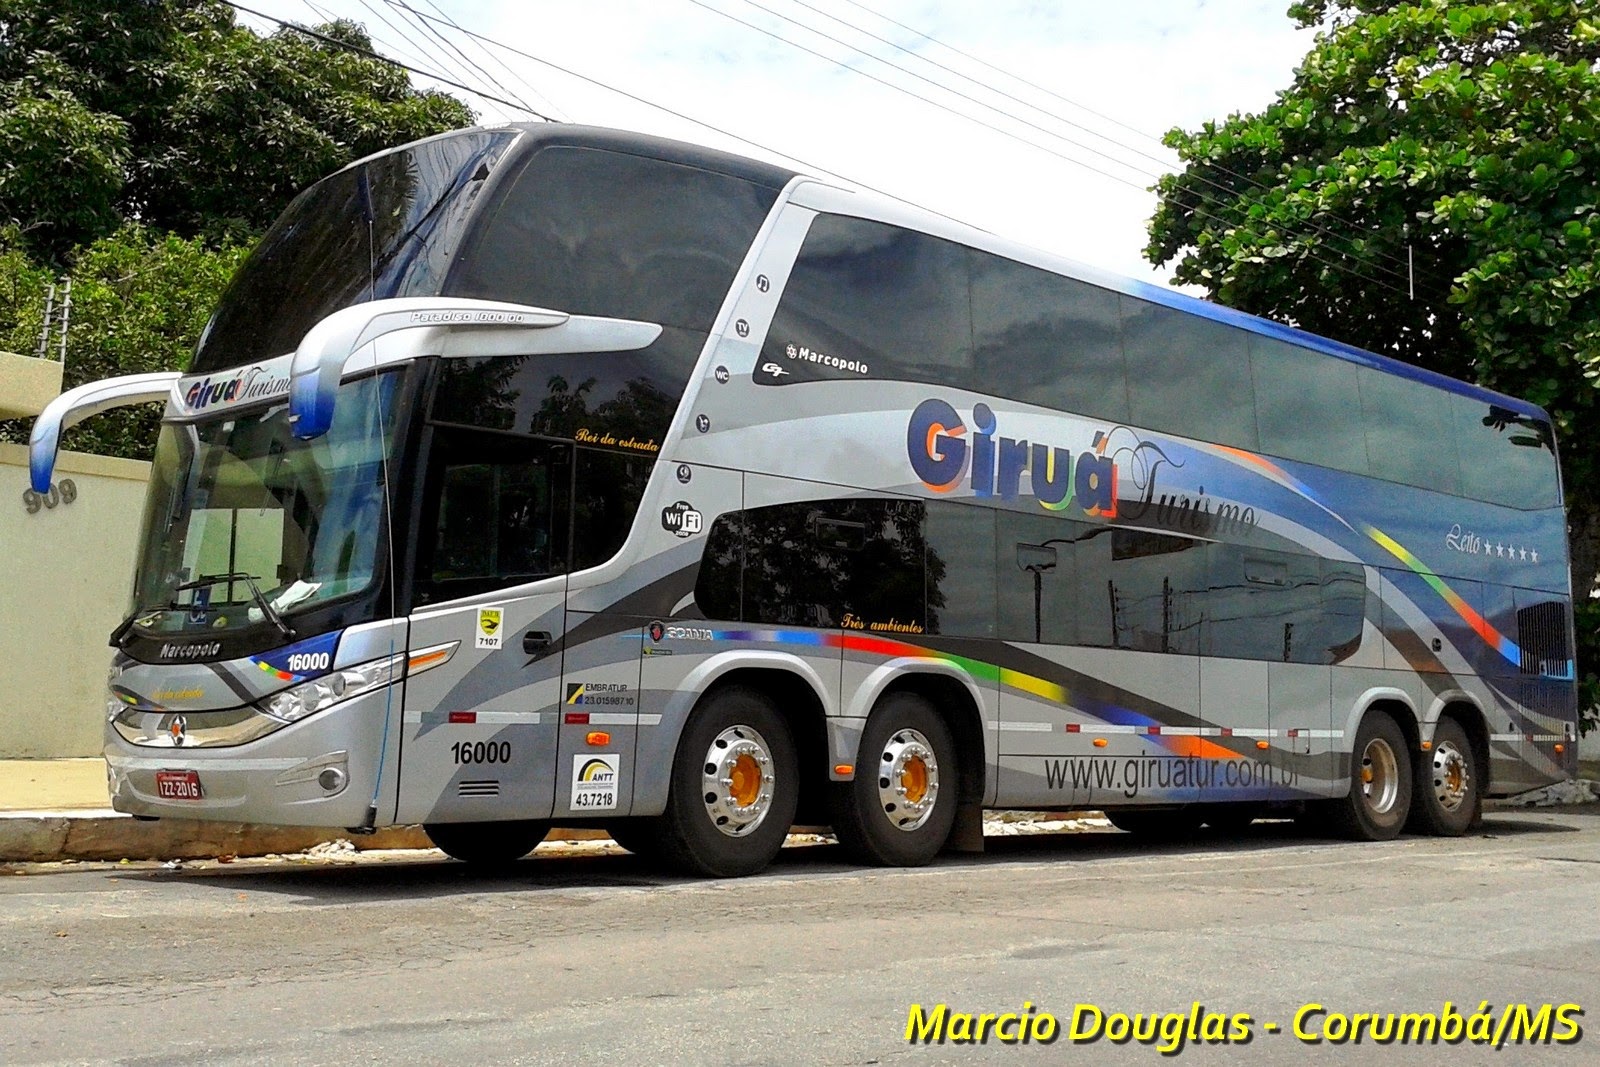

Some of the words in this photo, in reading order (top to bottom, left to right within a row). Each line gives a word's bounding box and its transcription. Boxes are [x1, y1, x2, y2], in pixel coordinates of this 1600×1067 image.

[410, 311, 471, 323] Paradiso
[737, 322, 748, 331] TV
[798, 346, 868, 374] Marcopolo
[716, 370, 729, 380] WC
[186, 369, 245, 410] Giruá
[575, 428, 600, 443] Rei
[600, 432, 617, 445] da
[618, 436, 660, 452] estrada
[907, 398, 1118, 518] Giruá
[1104, 425, 1261, 536] Turismo
[22, 478, 78, 515] 909
[676, 502, 690, 511] Free
[1446, 523, 1481, 554] Leito
[840, 612, 865, 629] Três
[870, 617, 925, 634] ambientes
[159, 641, 221, 660] Marcopolo
[479, 638, 498, 646] 7107
[287, 652, 329, 672] 16000
[585, 682, 628, 693] EMBRATUR
[450, 741, 512, 764] 16000
[591, 773, 614, 782] ANTT
[1045, 750, 1301, 797] www.giruatur.com.br
[575, 793, 613, 807] 43.7218
